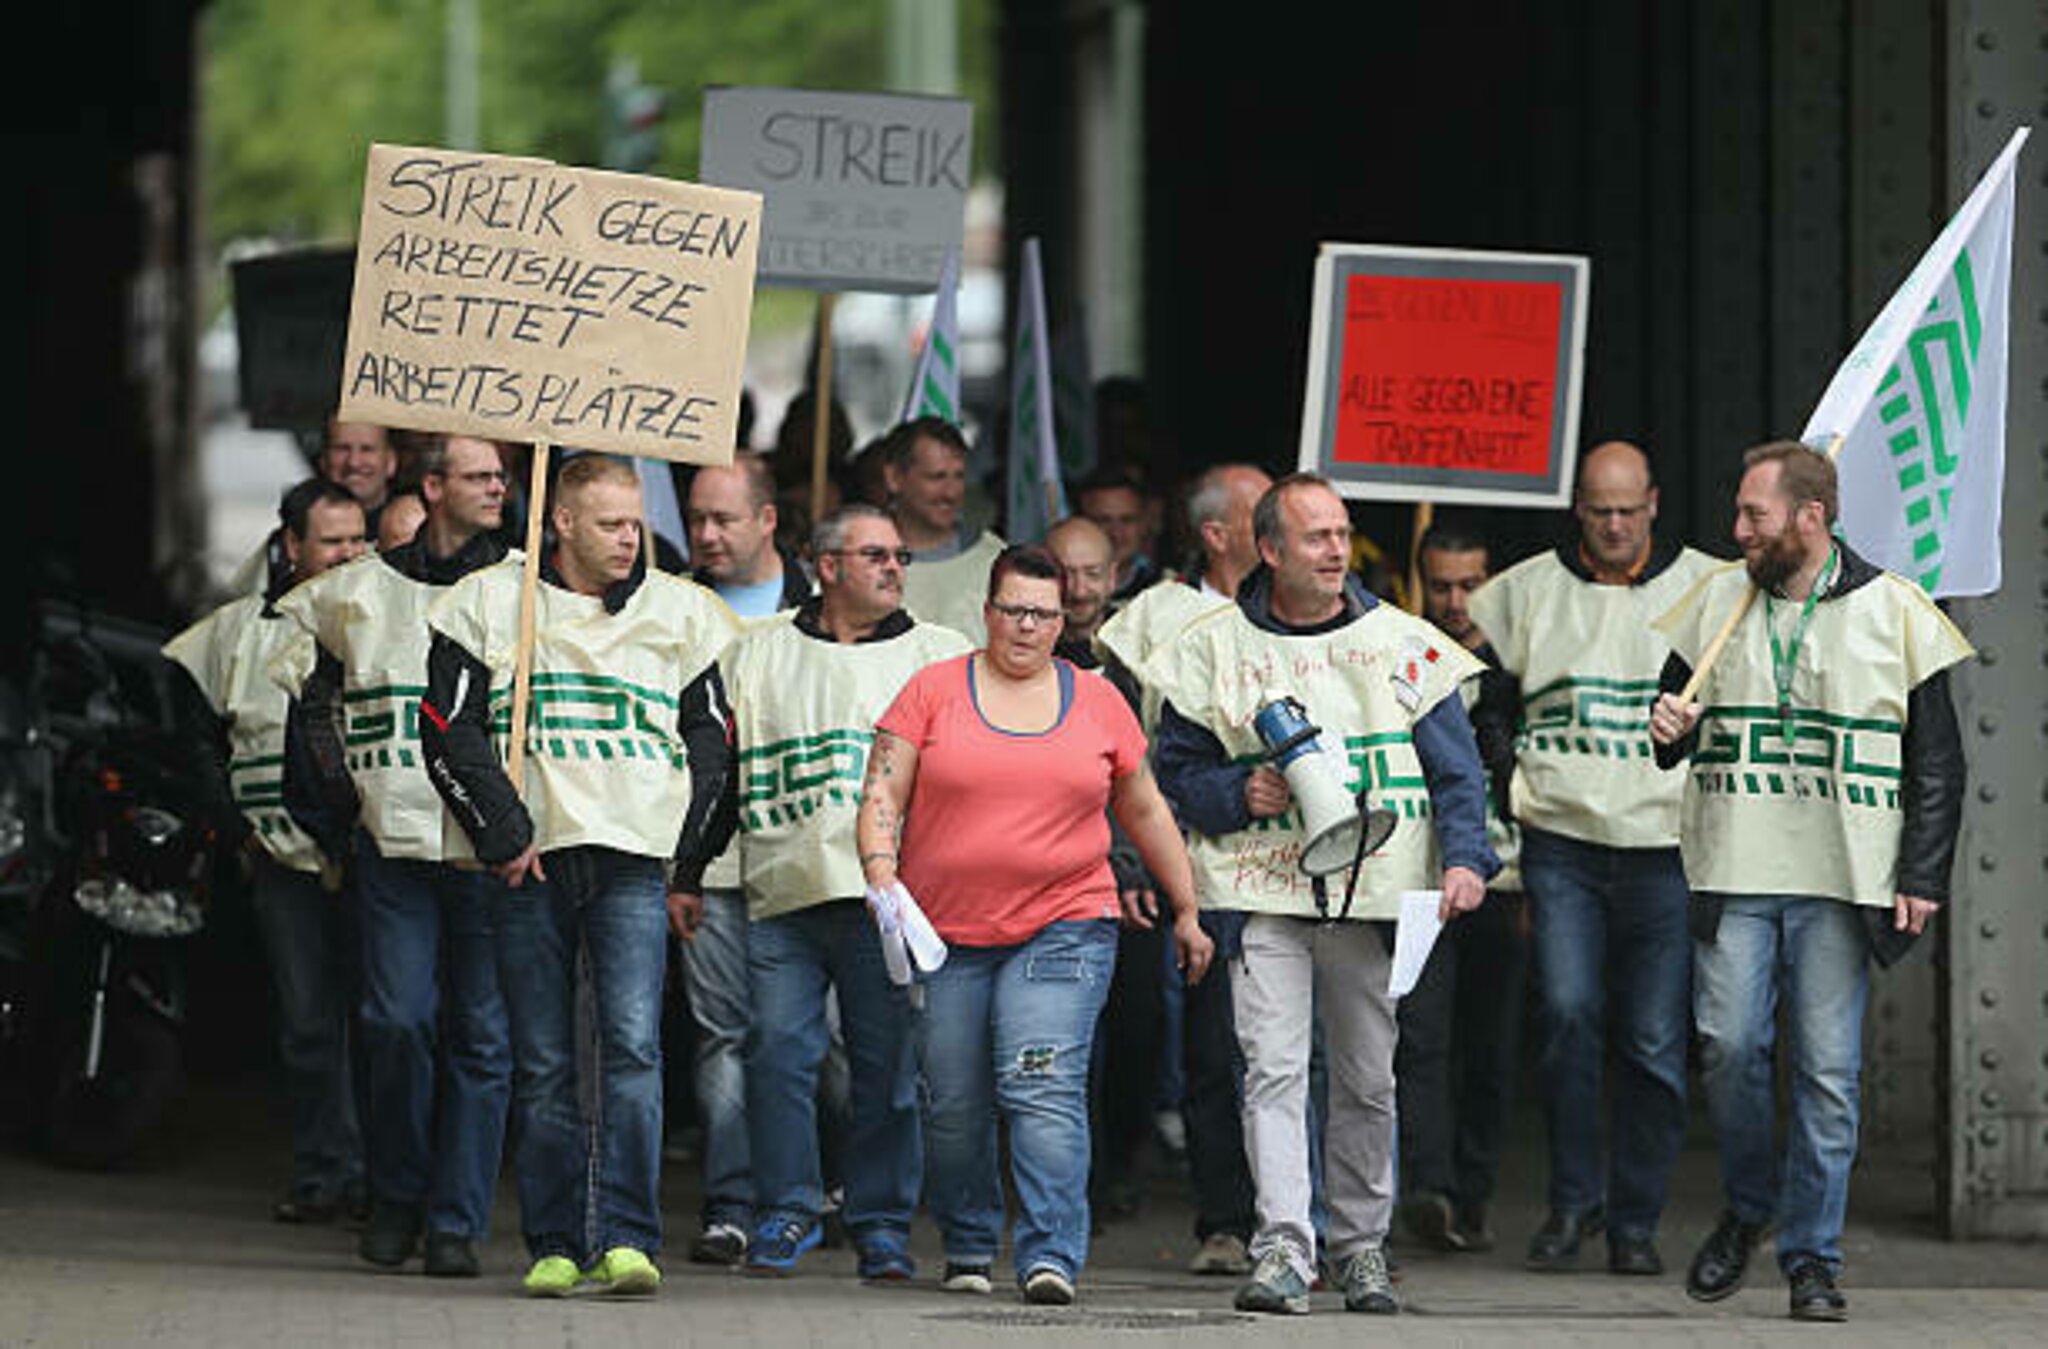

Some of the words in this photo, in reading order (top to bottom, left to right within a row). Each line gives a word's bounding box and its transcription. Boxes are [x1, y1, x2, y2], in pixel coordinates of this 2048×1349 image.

[754, 111, 966, 192] STREIK
[378, 159, 577, 238] STREIK
[597, 199, 748, 259] GEGEN
[373, 231, 707, 329] ARBEITSHETZE
[380, 290, 605, 349] RETTET
